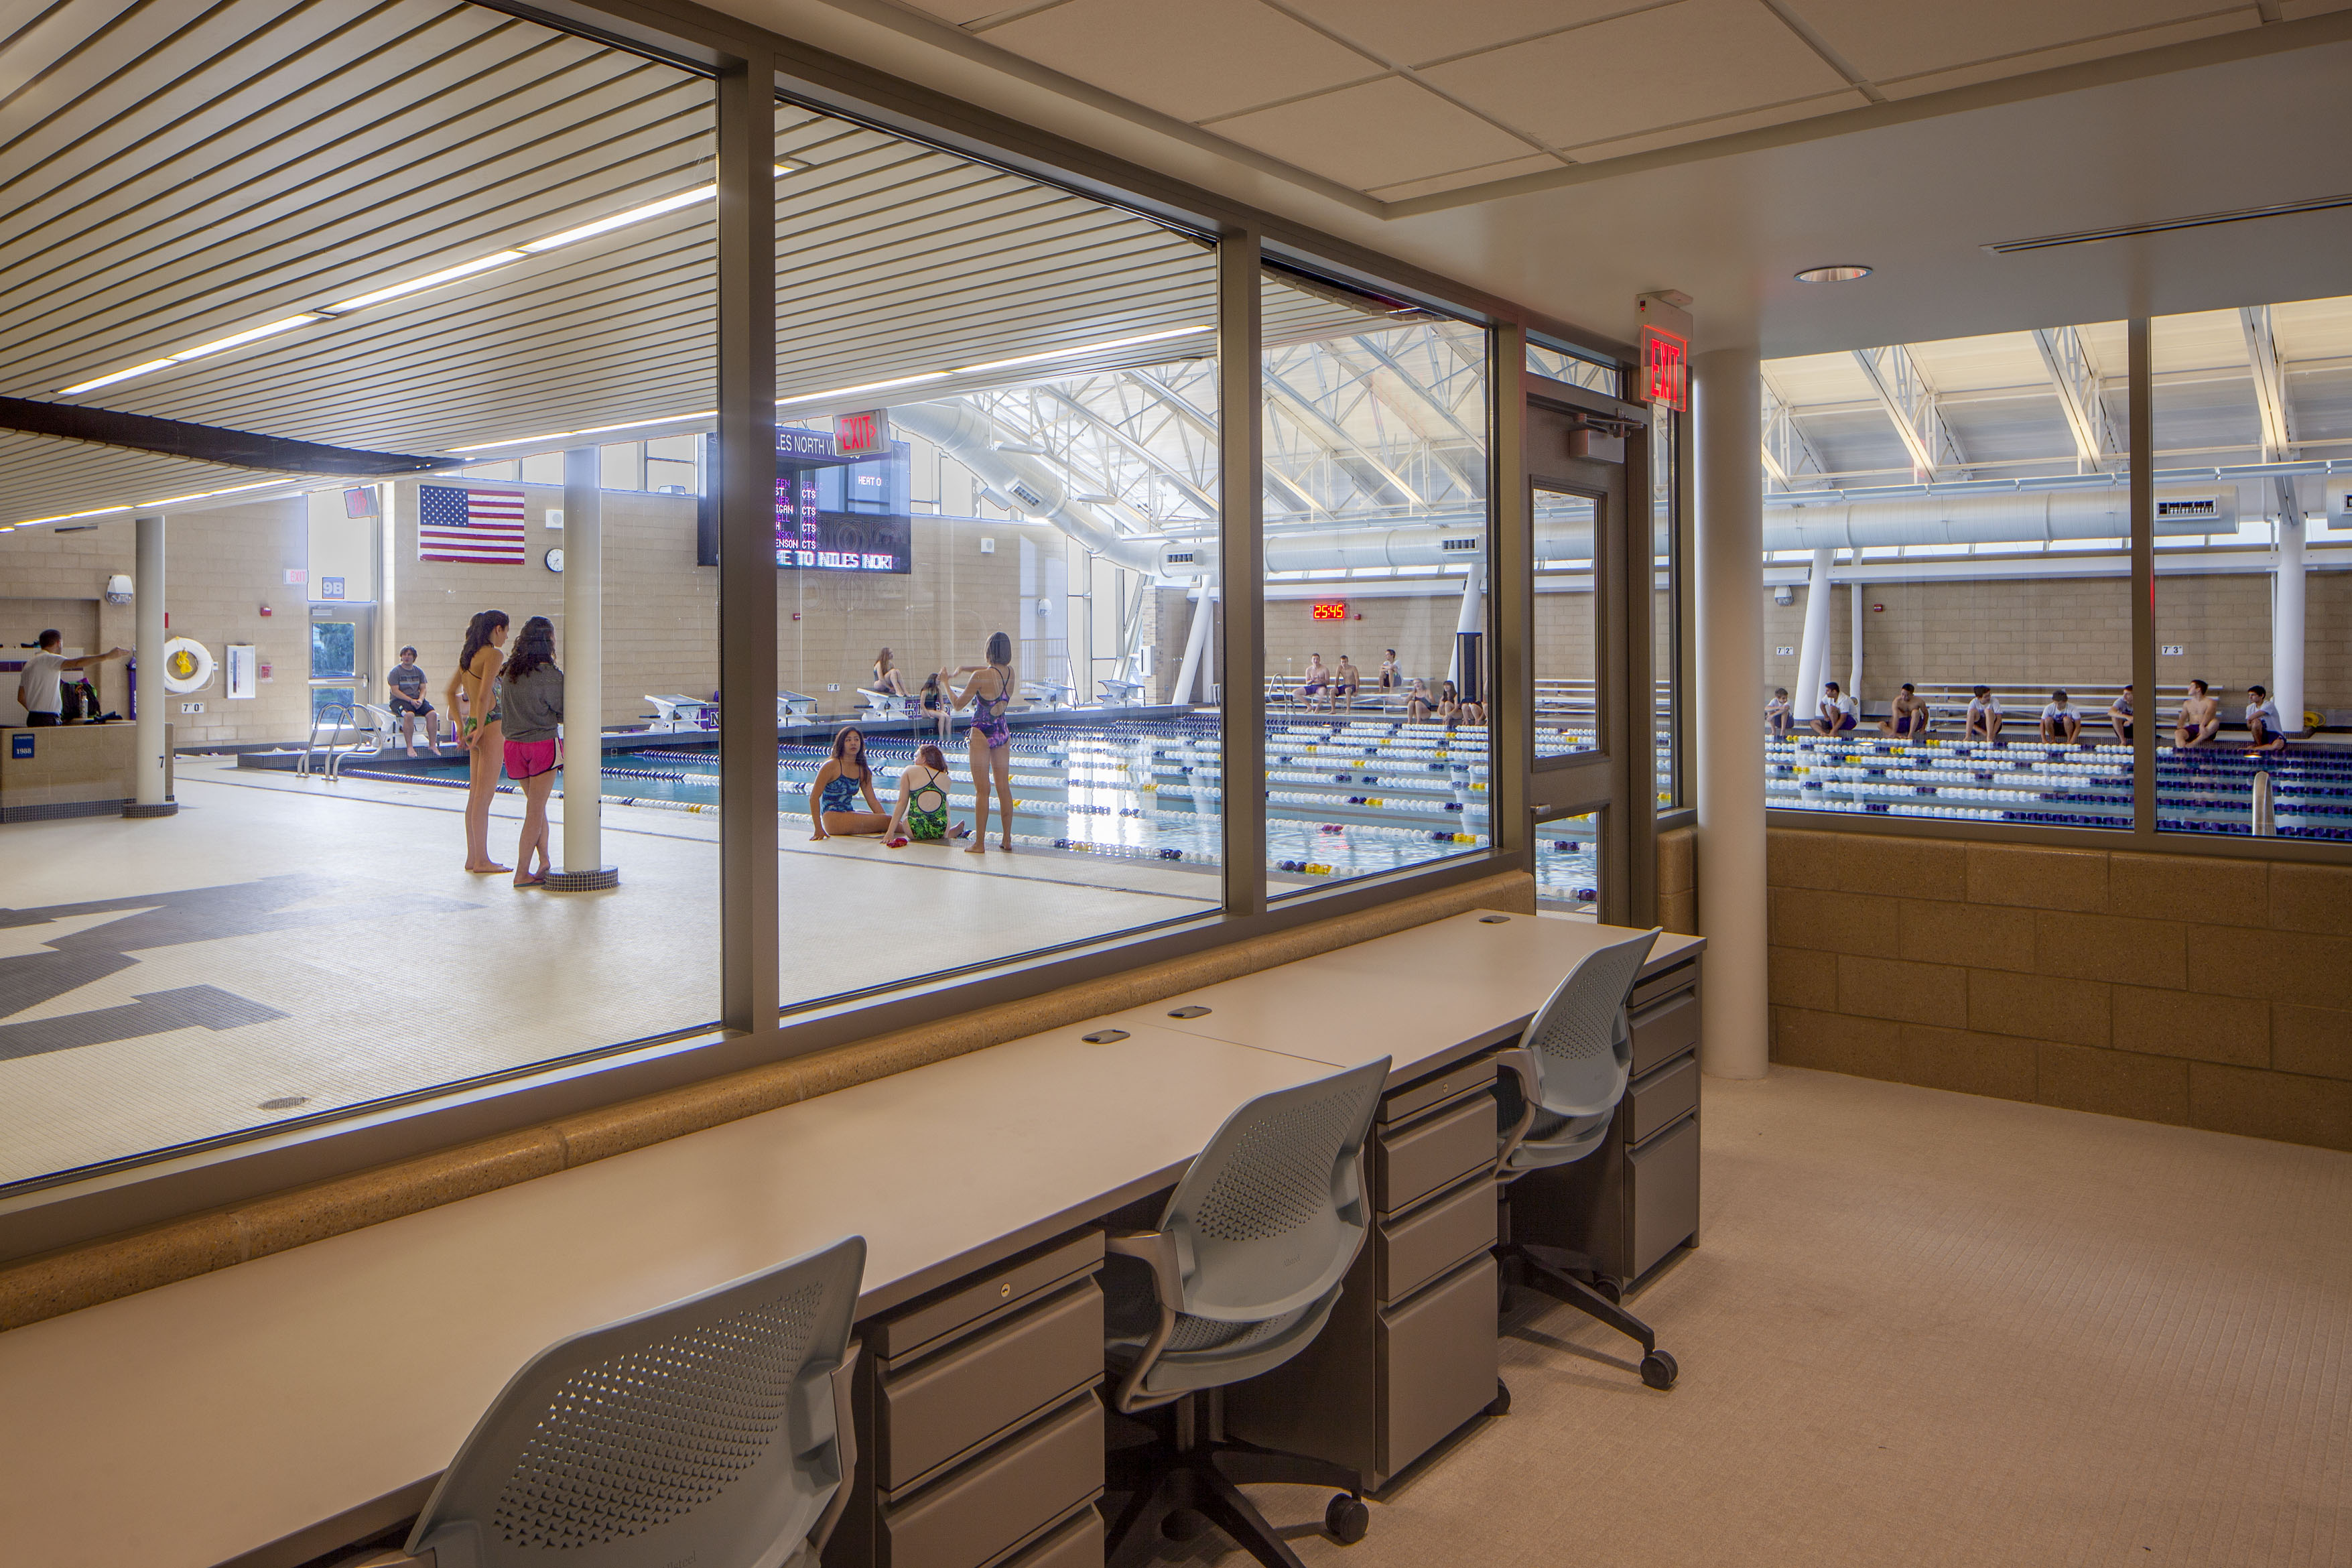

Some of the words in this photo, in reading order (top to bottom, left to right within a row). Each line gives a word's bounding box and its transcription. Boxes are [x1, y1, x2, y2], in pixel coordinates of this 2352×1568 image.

[1651, 338, 1679, 403] EXIT
[841, 415, 871, 450] EXIT
[795, 436, 825, 456] NORTH
[858, 476, 874, 486] HEAT
[801, 489, 816, 499] CTS
[801, 506, 816, 515] CTS
[801, 523, 816, 533] CTS
[801, 540, 816, 549] CTS
[817, 551, 858, 568] NILES
[290, 570, 306, 582] EXIT
[323, 582, 344, 594] 9B
[1314, 605, 1343, 618] 25:45
